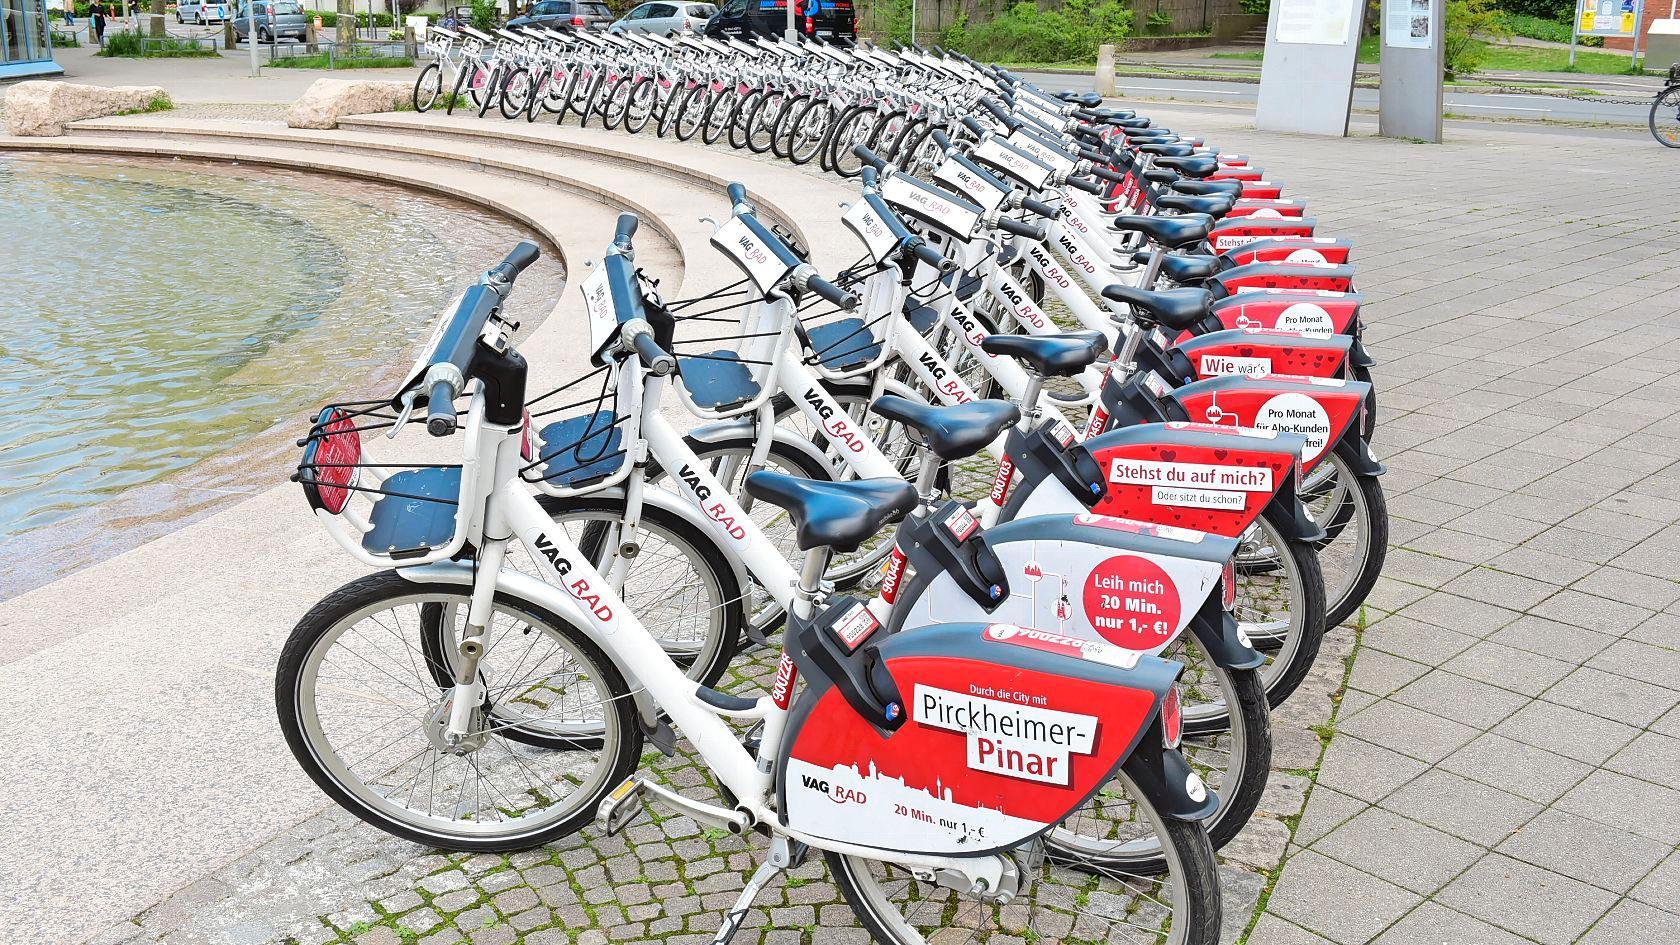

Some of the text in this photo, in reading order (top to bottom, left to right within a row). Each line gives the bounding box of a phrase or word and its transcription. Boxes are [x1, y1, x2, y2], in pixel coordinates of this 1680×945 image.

[1000, 151, 1013, 162] VAG
[1027, 143, 1040, 154] VAG
[957, 171, 986, 193] VAG RAD
[909, 190, 951, 215] VAG RAD
[862, 212, 883, 238] VAG RAD
[1059, 204, 1088, 234] AG RAD
[738, 236, 766, 264] VAG RAD
[1058, 235, 1096, 274] VAG RAD
[1030, 247, 1070, 290] VAG RAD
[950, 306, 974, 333] VAG
[1000, 283, 1044, 329] VAG RAD
[1285, 316, 1298, 324] Pro
[918, 352, 947, 381] VAG
[1205, 358, 1234, 373] Wie
[804, 388, 864, 454] VAG RAD
[1268, 409, 1316, 418] Pro Monat
[1305, 438, 1323, 448] frei!
[992, 460, 1012, 500] 900703
[1116, 464, 1266, 486] Stehst du auf mich?
[678, 464, 747, 541] VAG RAD
[1157, 490, 1242, 505] Oder sitzt du schon?
[534, 532, 614, 622] VAG RAD
[882, 558, 902, 594] 90044
[1094, 573, 1164, 596] Leih mich
[1101, 594, 1162, 616] 20 Min.
[1094, 614, 1168, 635] nur 1,- €!
[970, 684, 1048, 706] Durch die City mit
[923, 693, 1086, 746] Pirckheimer-
[978, 736, 1058, 778] Pinar
[801, 774, 867, 804] VAG RAD
[894, 804, 908, 817] 20
[911, 808, 936, 825] Min.
[939, 818, 958, 830] nur
[978, 826, 985, 838] €
